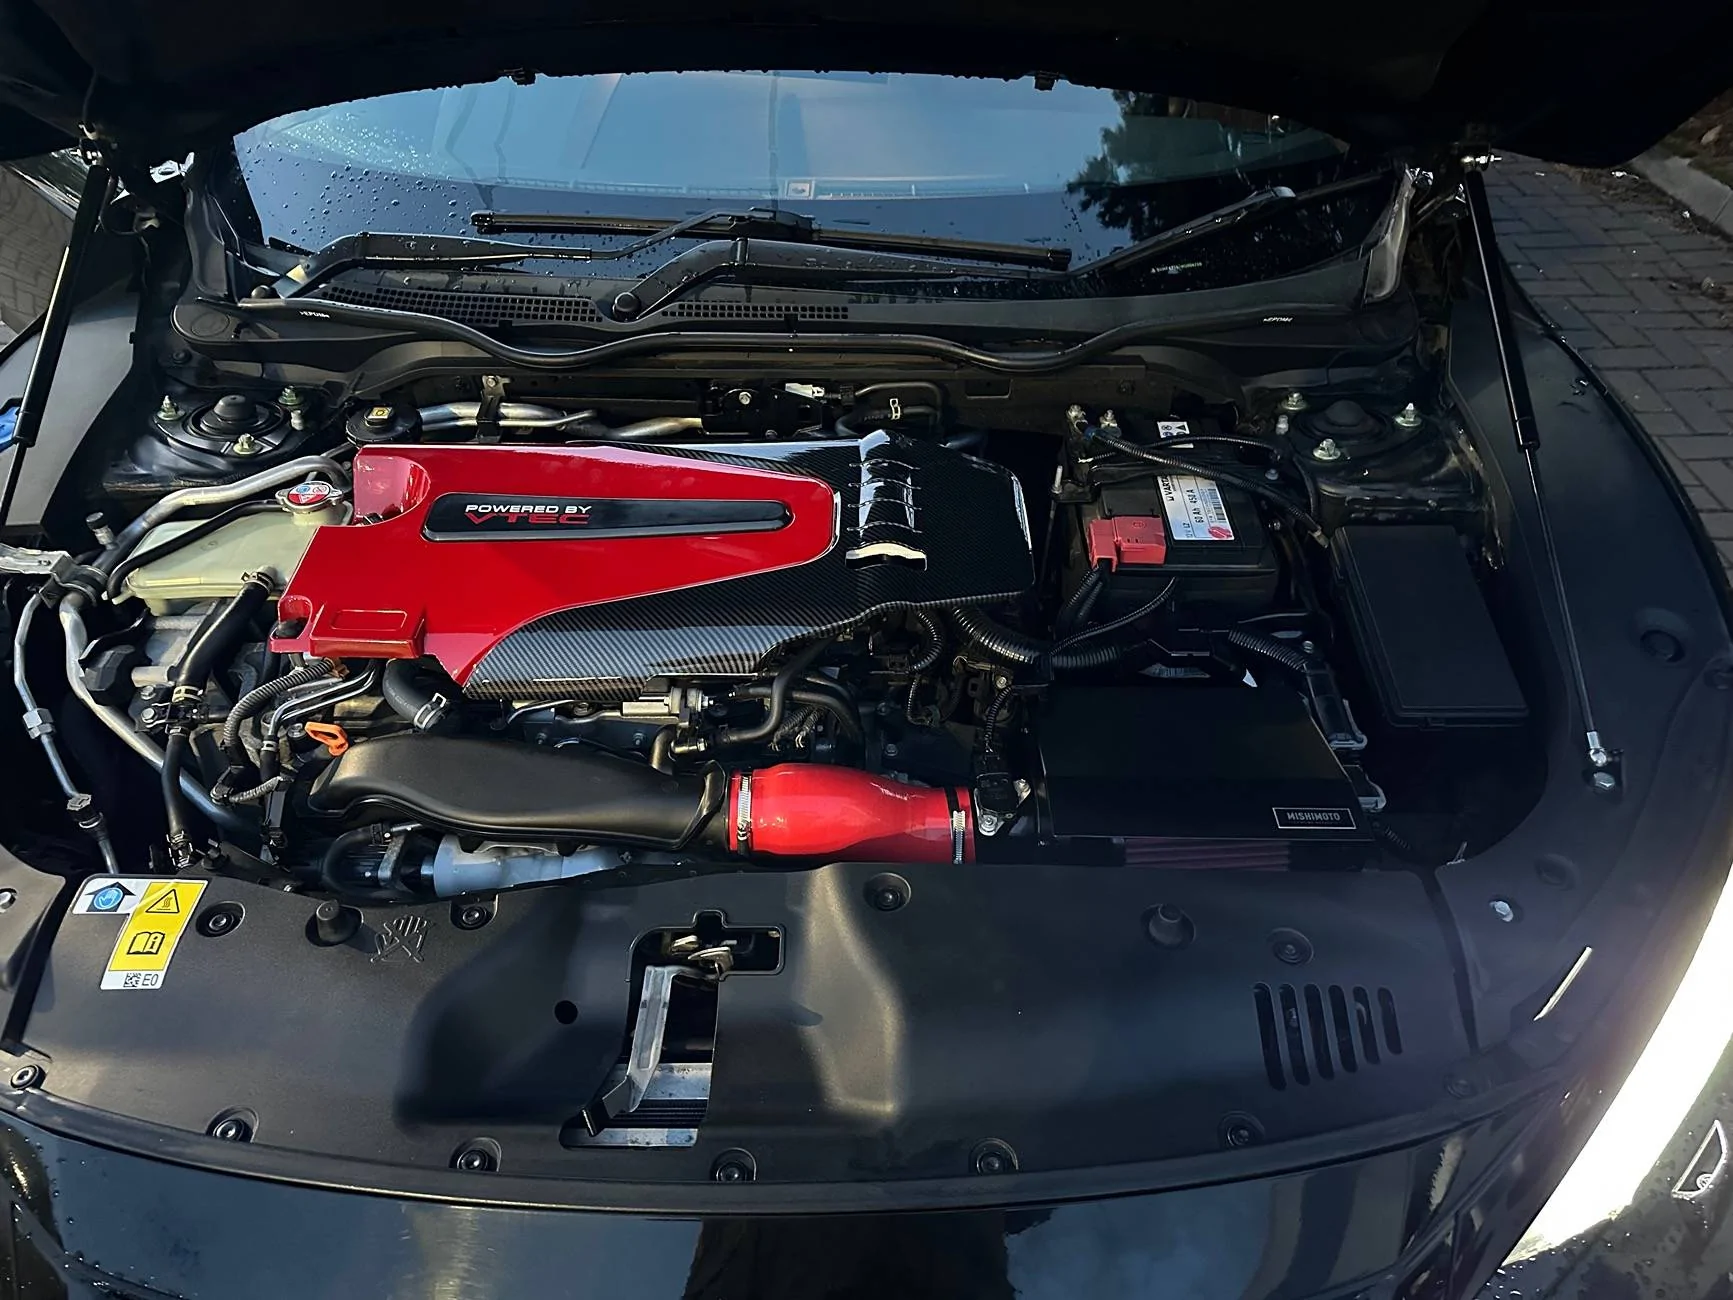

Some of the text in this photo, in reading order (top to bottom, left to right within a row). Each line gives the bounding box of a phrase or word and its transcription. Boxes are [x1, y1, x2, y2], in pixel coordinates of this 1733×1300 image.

[465, 504, 592, 514] POWERED BY
[1191, 507, 1201, 516] Ah
[464, 512, 590, 525] VTEC
[1286, 812, 1341, 821] MISHIMOTO
